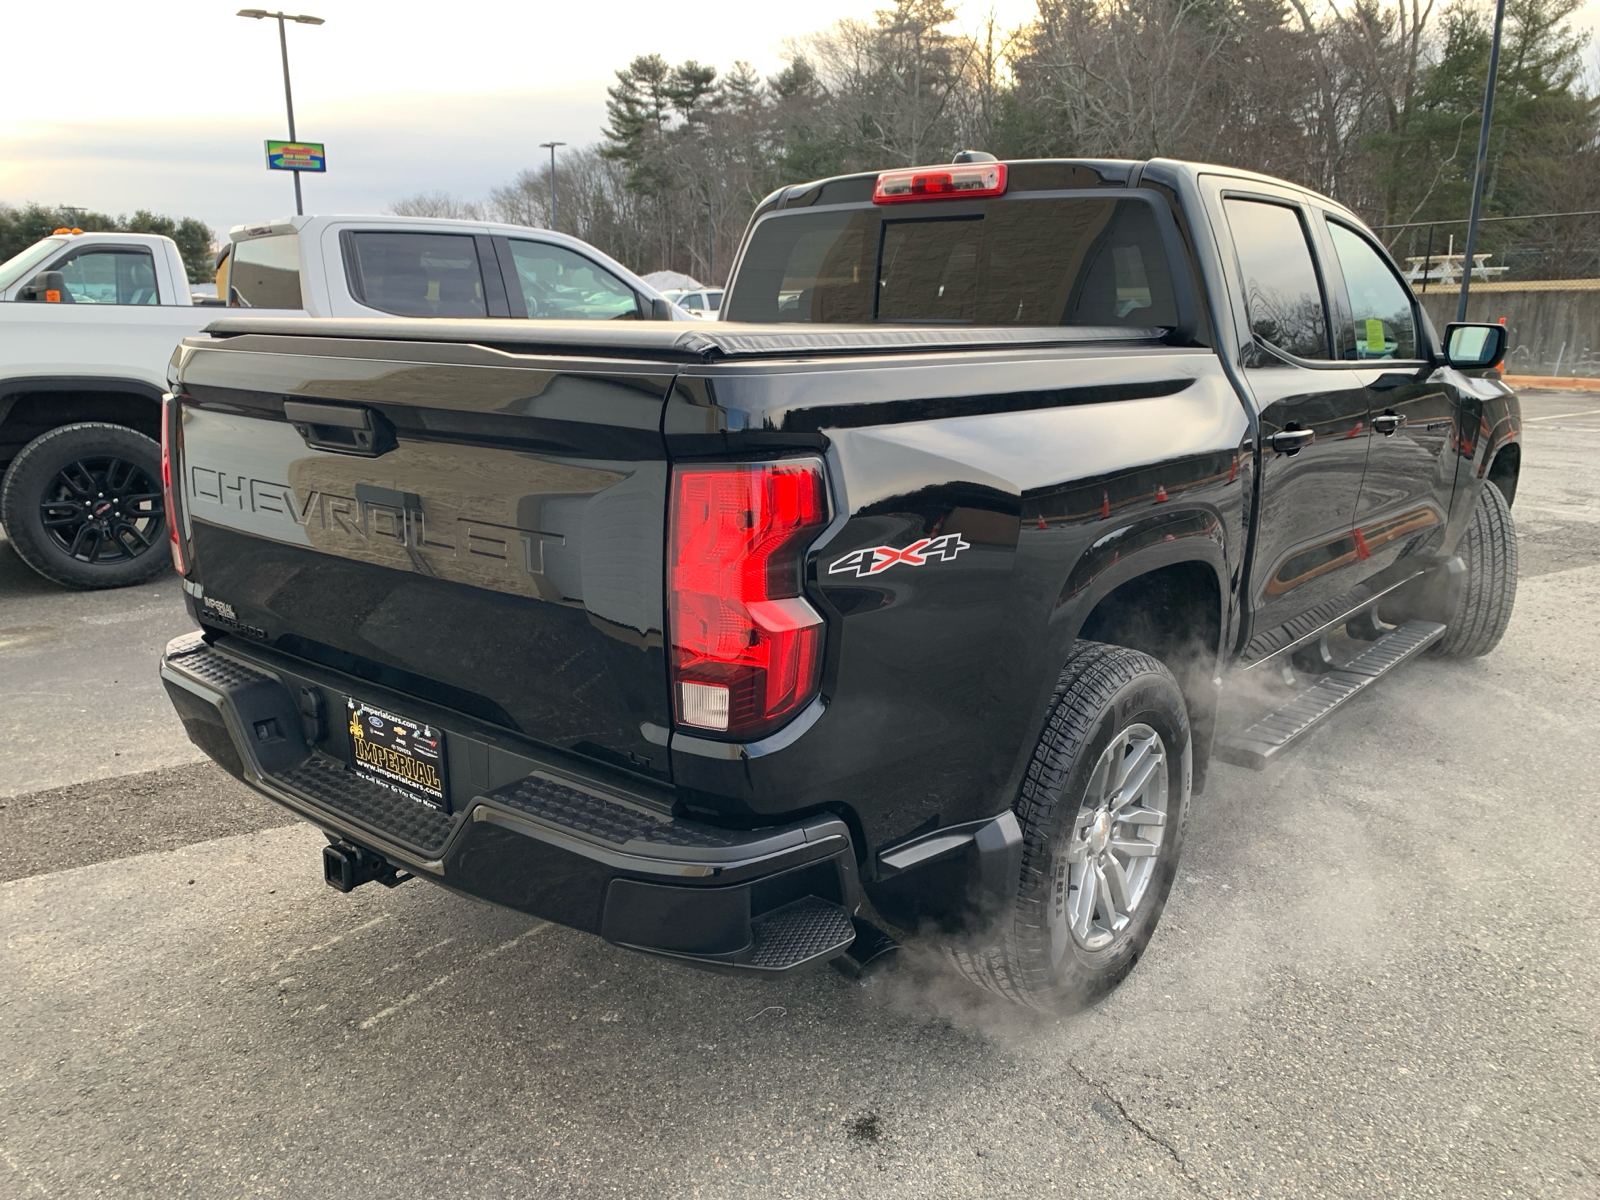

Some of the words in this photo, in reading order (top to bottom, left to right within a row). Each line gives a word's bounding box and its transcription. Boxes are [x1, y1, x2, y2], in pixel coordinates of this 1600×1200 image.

[191, 466, 566, 575] CHEVROLET
[360, 703, 418, 731] Imperialcars.com
[354, 737, 442, 791] IMPERIAL
[396, 745, 412, 756] TOYOTA
[356, 759, 443, 799] www.imperialcars.com
[390, 785, 398, 793] So
[398, 788, 409, 798] You
[422, 799, 437, 810] More
